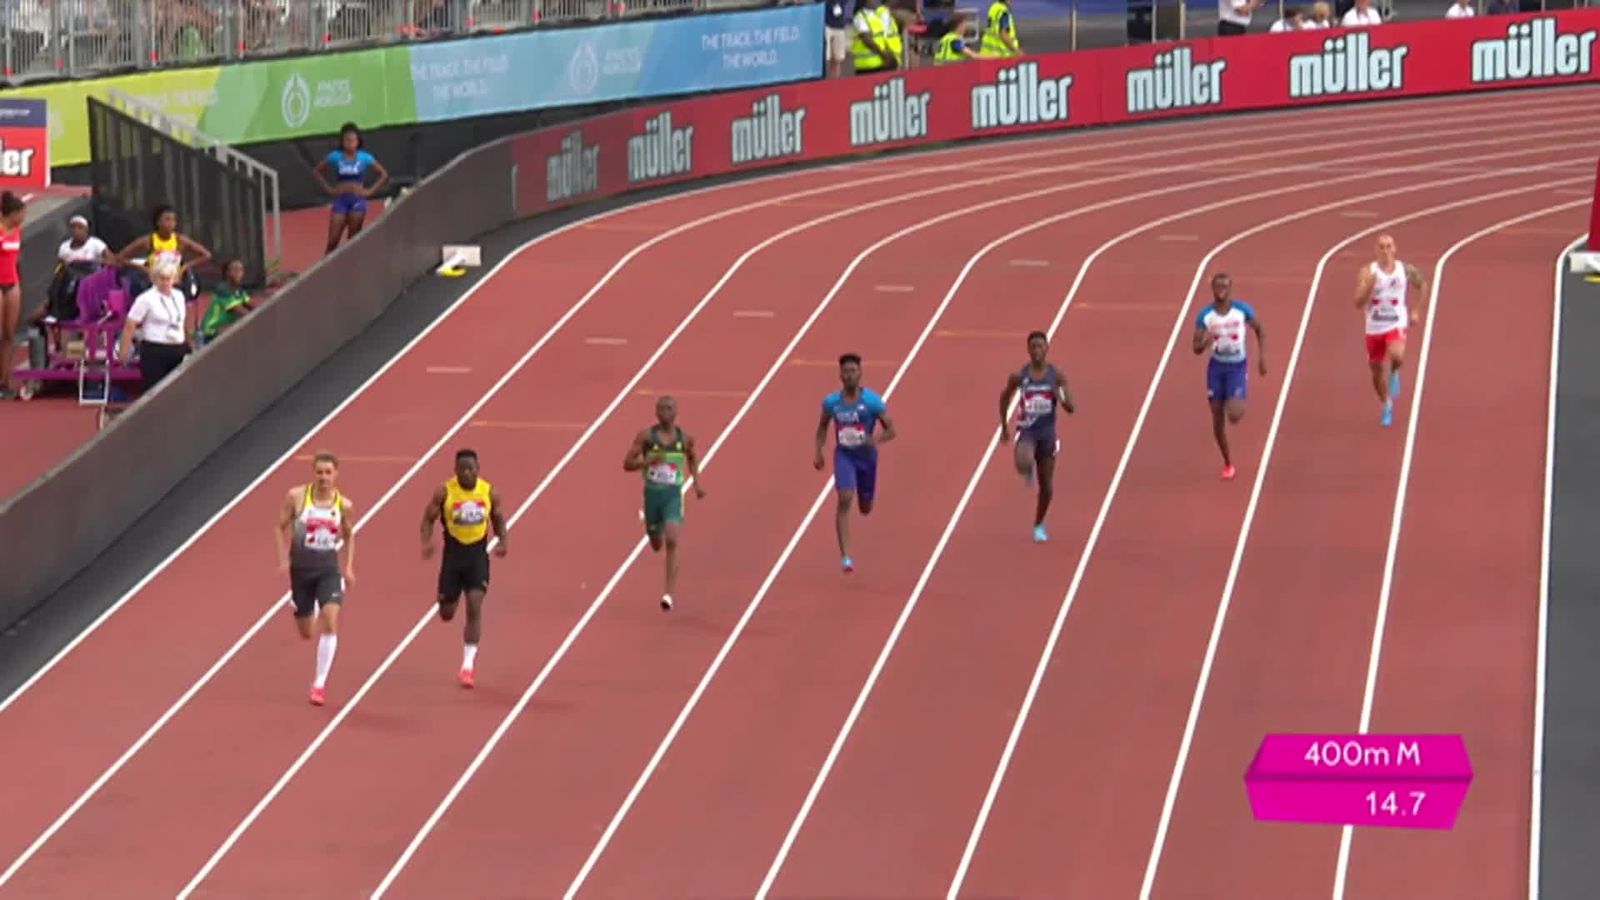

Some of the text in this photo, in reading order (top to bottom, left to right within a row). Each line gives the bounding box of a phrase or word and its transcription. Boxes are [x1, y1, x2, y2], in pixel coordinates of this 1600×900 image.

[1127, 47, 1226, 112] müller
[1290, 32, 1408, 97] müller
[1472, 17, 1597, 83] müller
[850, 78, 930, 145] müller
[971, 62, 1072, 128] müller
[0, 138, 34, 176] er
[628, 111, 693, 181] müller
[731, 94, 806, 163] müller
[547, 130, 599, 201] müller
